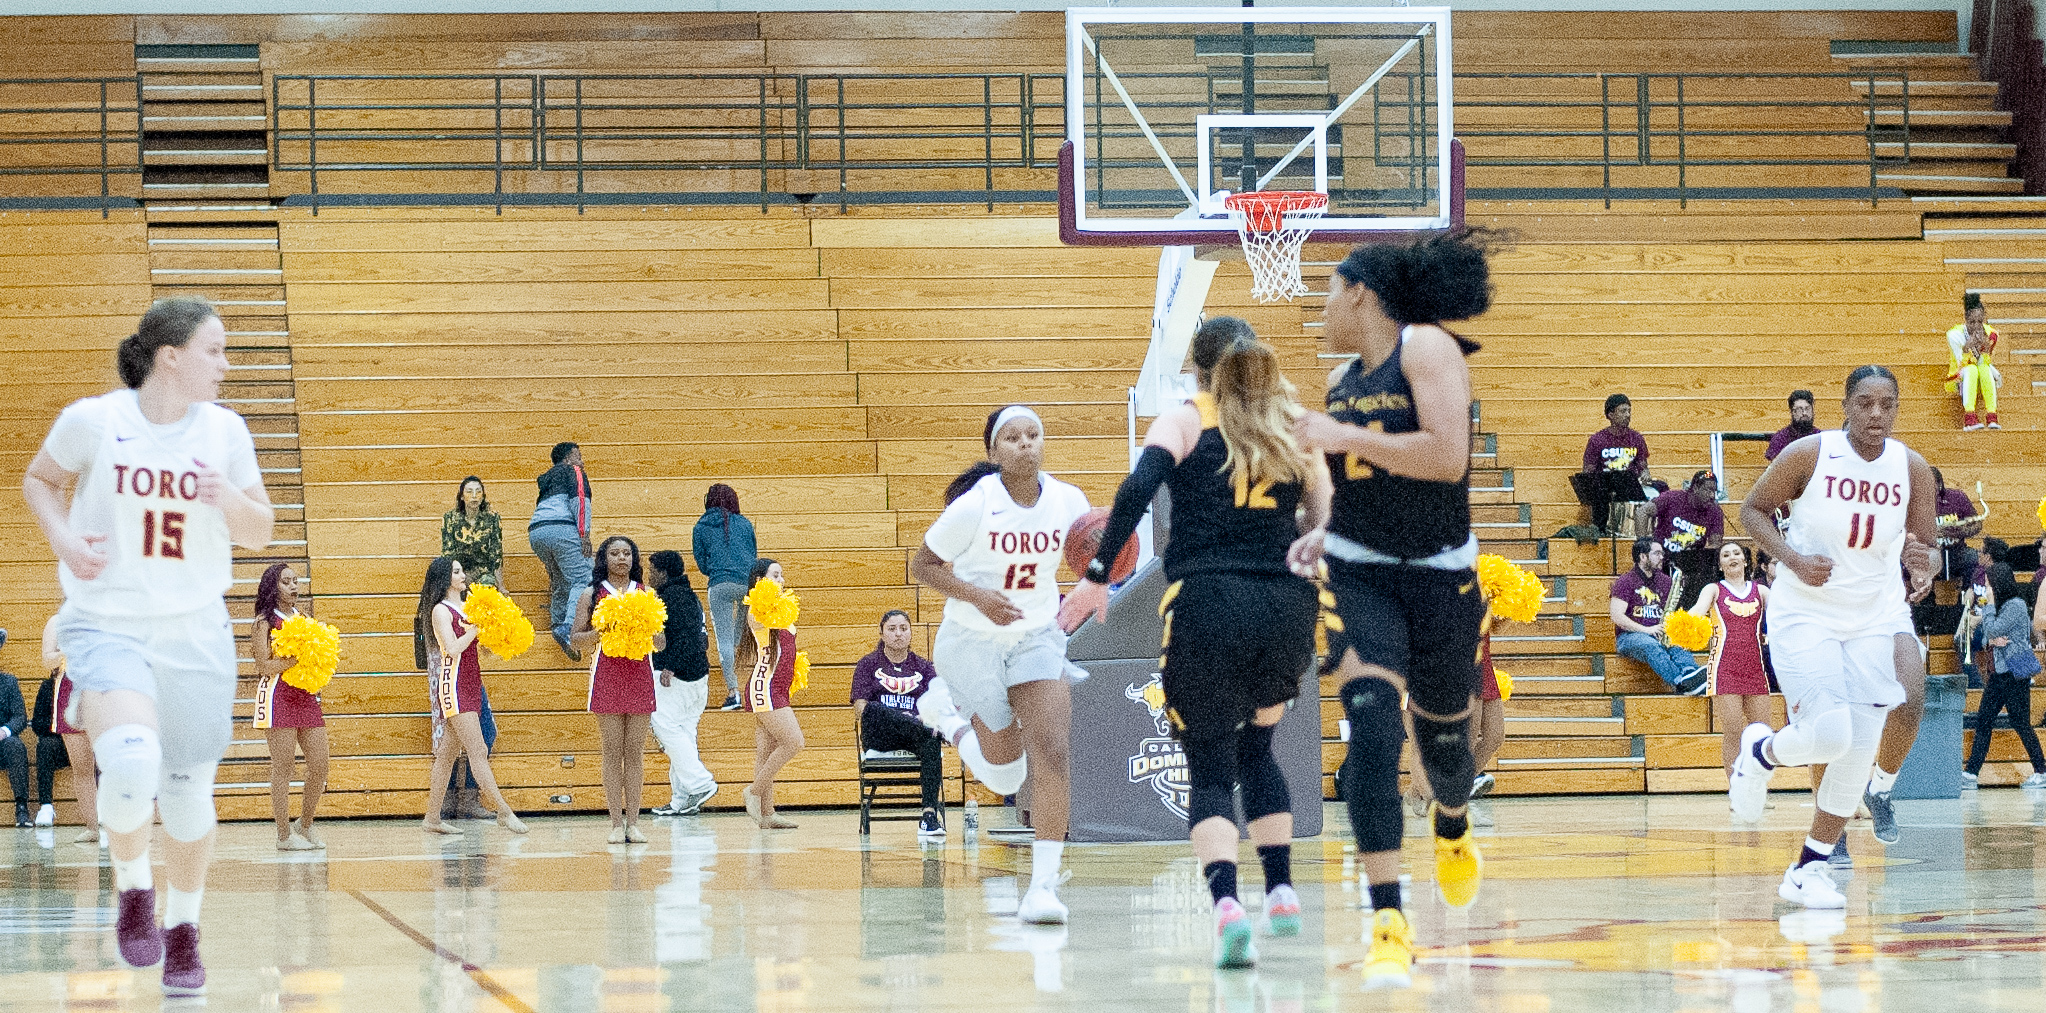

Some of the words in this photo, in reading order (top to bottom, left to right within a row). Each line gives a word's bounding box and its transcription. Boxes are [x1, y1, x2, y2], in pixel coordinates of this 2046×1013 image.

[1601, 447, 1638, 459] CSUDH
[114, 463, 199, 501] TORO
[1234, 466, 1278, 509] 12
[1824, 475, 1902, 507] TOROS
[143, 508, 186, 559] 15
[1847, 513, 1875, 550] 11
[1936, 512, 1959, 526] UDH
[988, 529, 1061, 554] TOROS
[1004, 563, 1038, 590] 12
[442, 654, 454, 711] OROS
[257, 674, 271, 721] ROS
[1148, 743, 1182, 753] CAL
[1132, 752, 1187, 777] DOMI
[1167, 768, 1190, 782] HI
